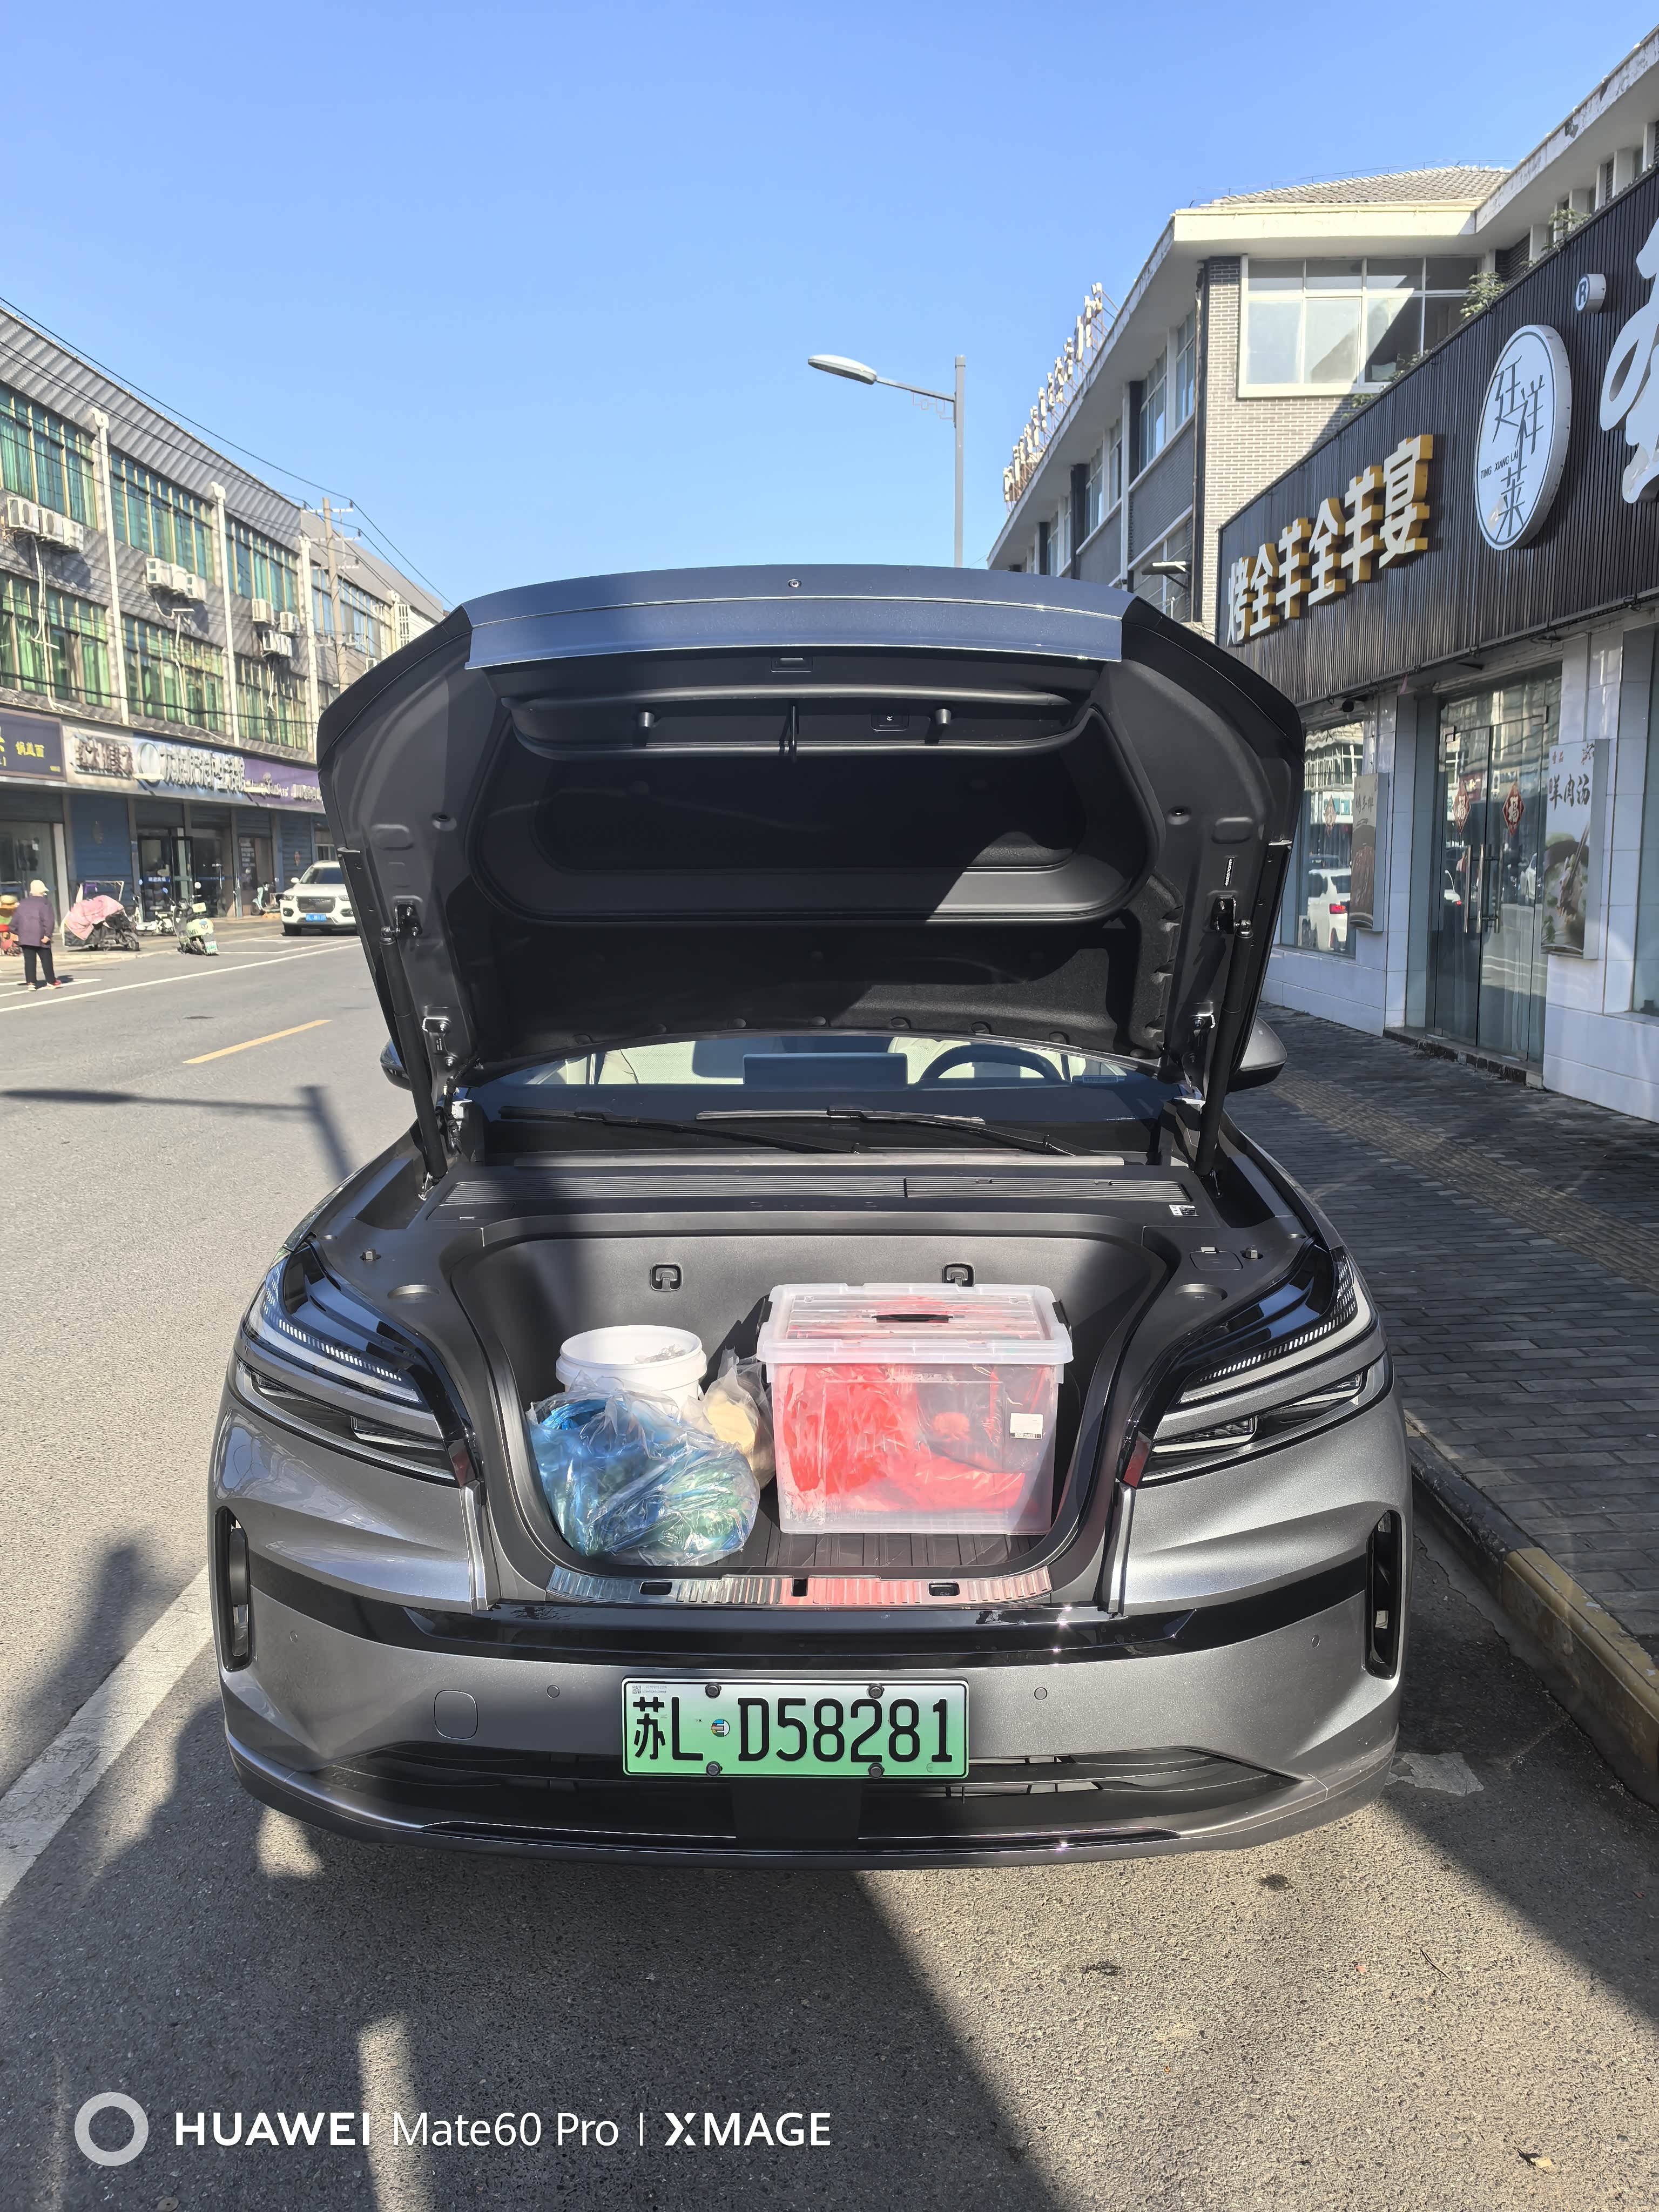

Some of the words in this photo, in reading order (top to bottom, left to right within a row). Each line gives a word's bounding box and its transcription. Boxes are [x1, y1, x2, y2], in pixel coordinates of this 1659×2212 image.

[1481, 465, 1492, 480] TING
[1494, 455, 1509, 472] XIANG
[1510, 449, 1519, 462] LAI
[1227, 434, 1432, 647] 烤全羊全羊宴
